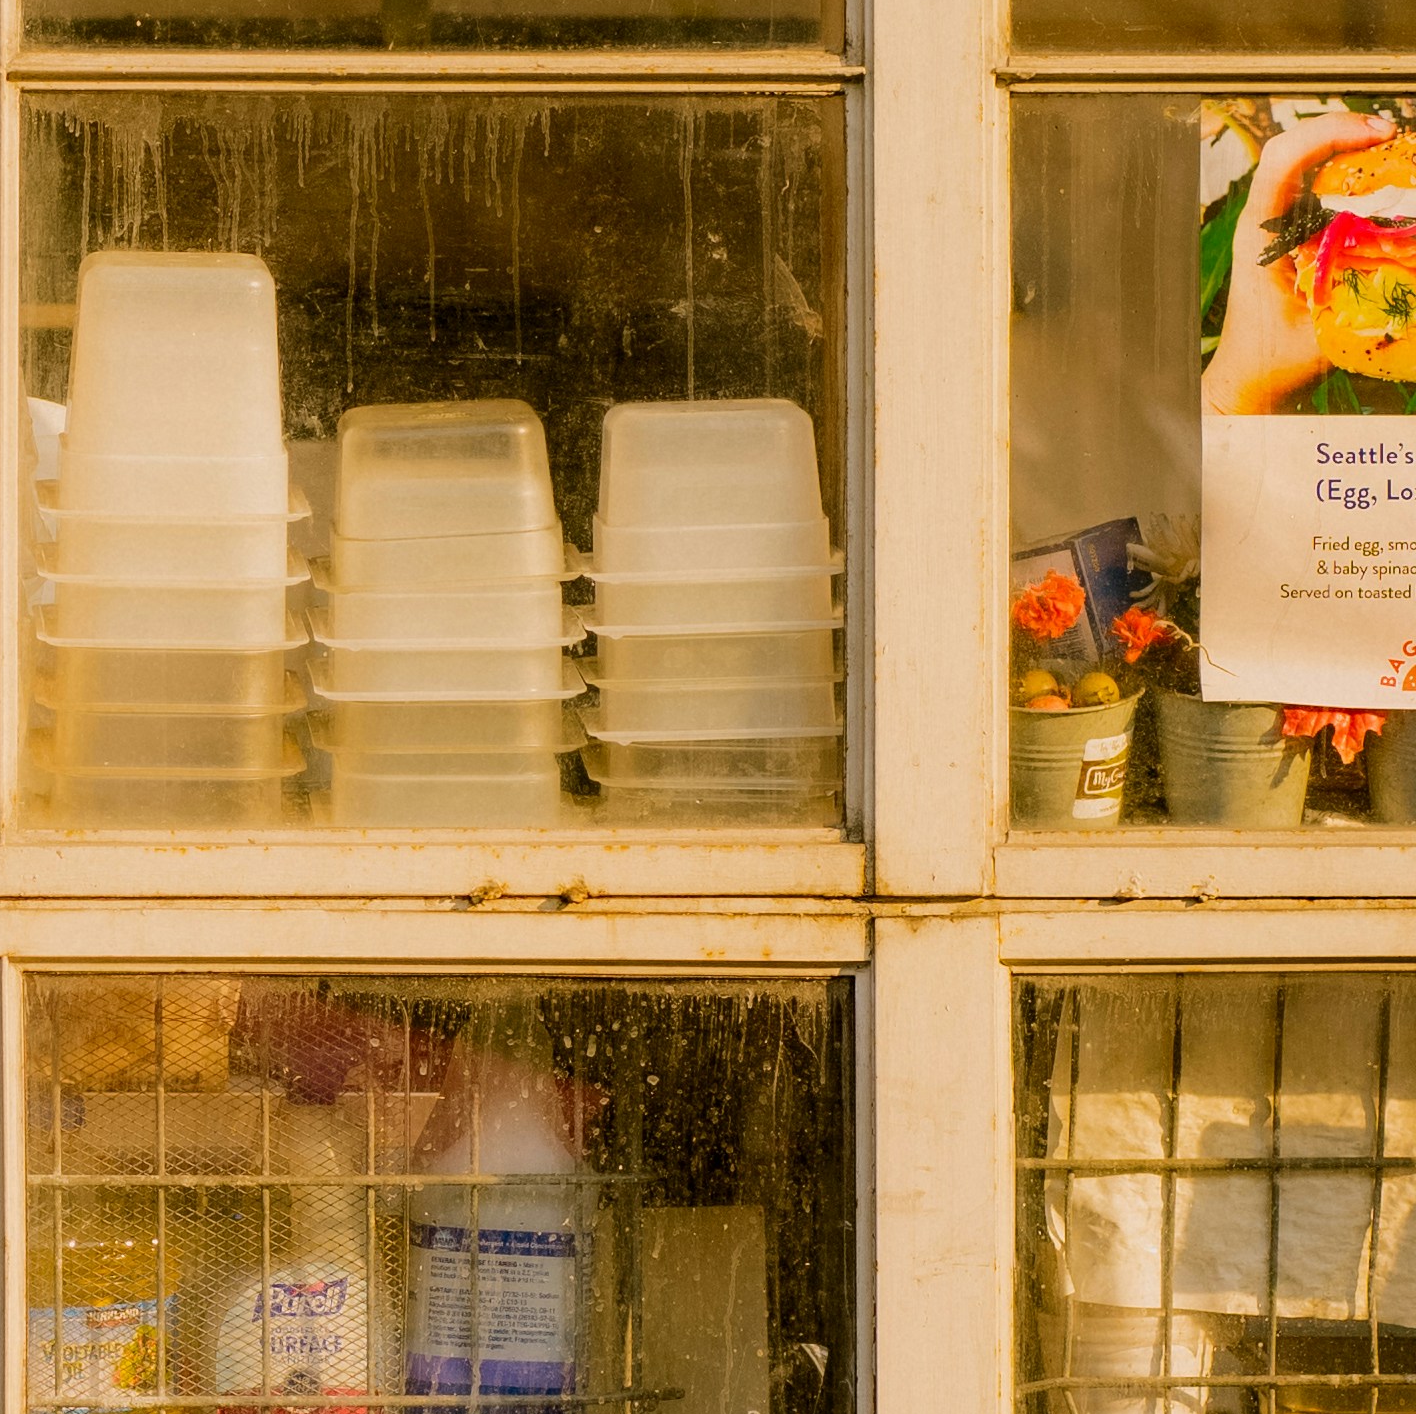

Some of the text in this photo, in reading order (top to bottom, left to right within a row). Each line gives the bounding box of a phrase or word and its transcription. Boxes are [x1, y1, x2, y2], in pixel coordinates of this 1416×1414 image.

[1316, 442, 1414, 464] Seattle's
[1316, 479, 1416, 509] (Egg, Lo
[1313, 536, 1350, 551] Fried
[1354, 541, 1384, 556] egg,
[1317, 560, 1329, 575] &
[1333, 560, 1368, 580] baby
[1280, 584, 1412, 599] Served on toasted
